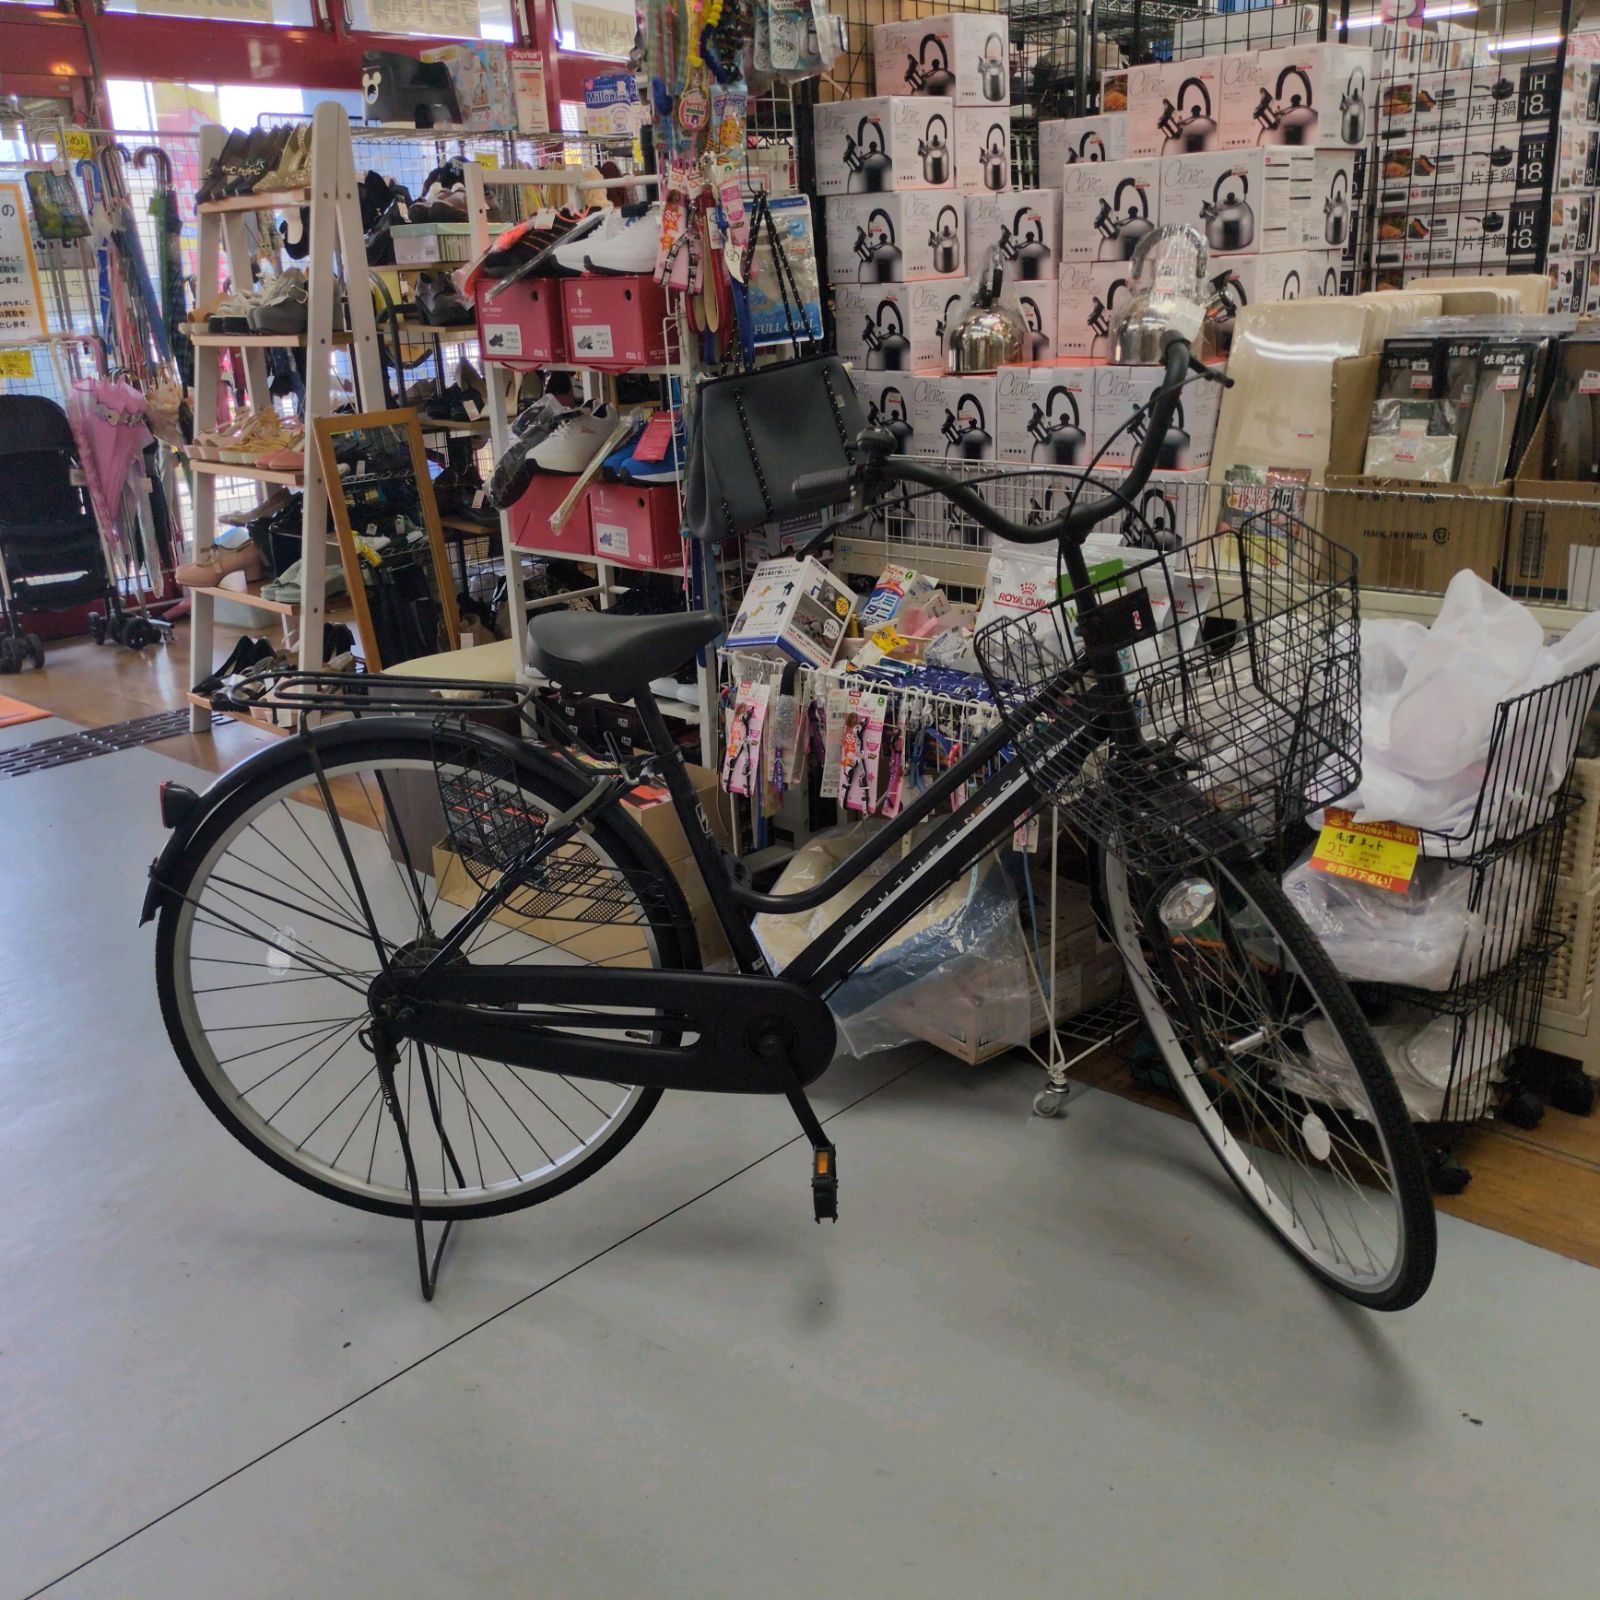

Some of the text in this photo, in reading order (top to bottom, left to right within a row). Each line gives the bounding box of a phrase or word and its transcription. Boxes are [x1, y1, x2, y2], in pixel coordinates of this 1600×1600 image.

[1529, 74, 1546, 91] IH
[1471, 101, 1516, 121] 片手鍋
[1524, 94, 1544, 116] 18
[1528, 143, 1544, 159] IH
[1470, 168, 1515, 185] 片手鍋
[1520, 162, 1543, 183] 18
[1519, 211, 1534, 226] IH
[1462, 234, 1506, 251] 片手鍋
[1512, 229, 1532, 249] 18
[754, 323, 781, 335] FULL
[998, 592, 1024, 606] ROYAL
